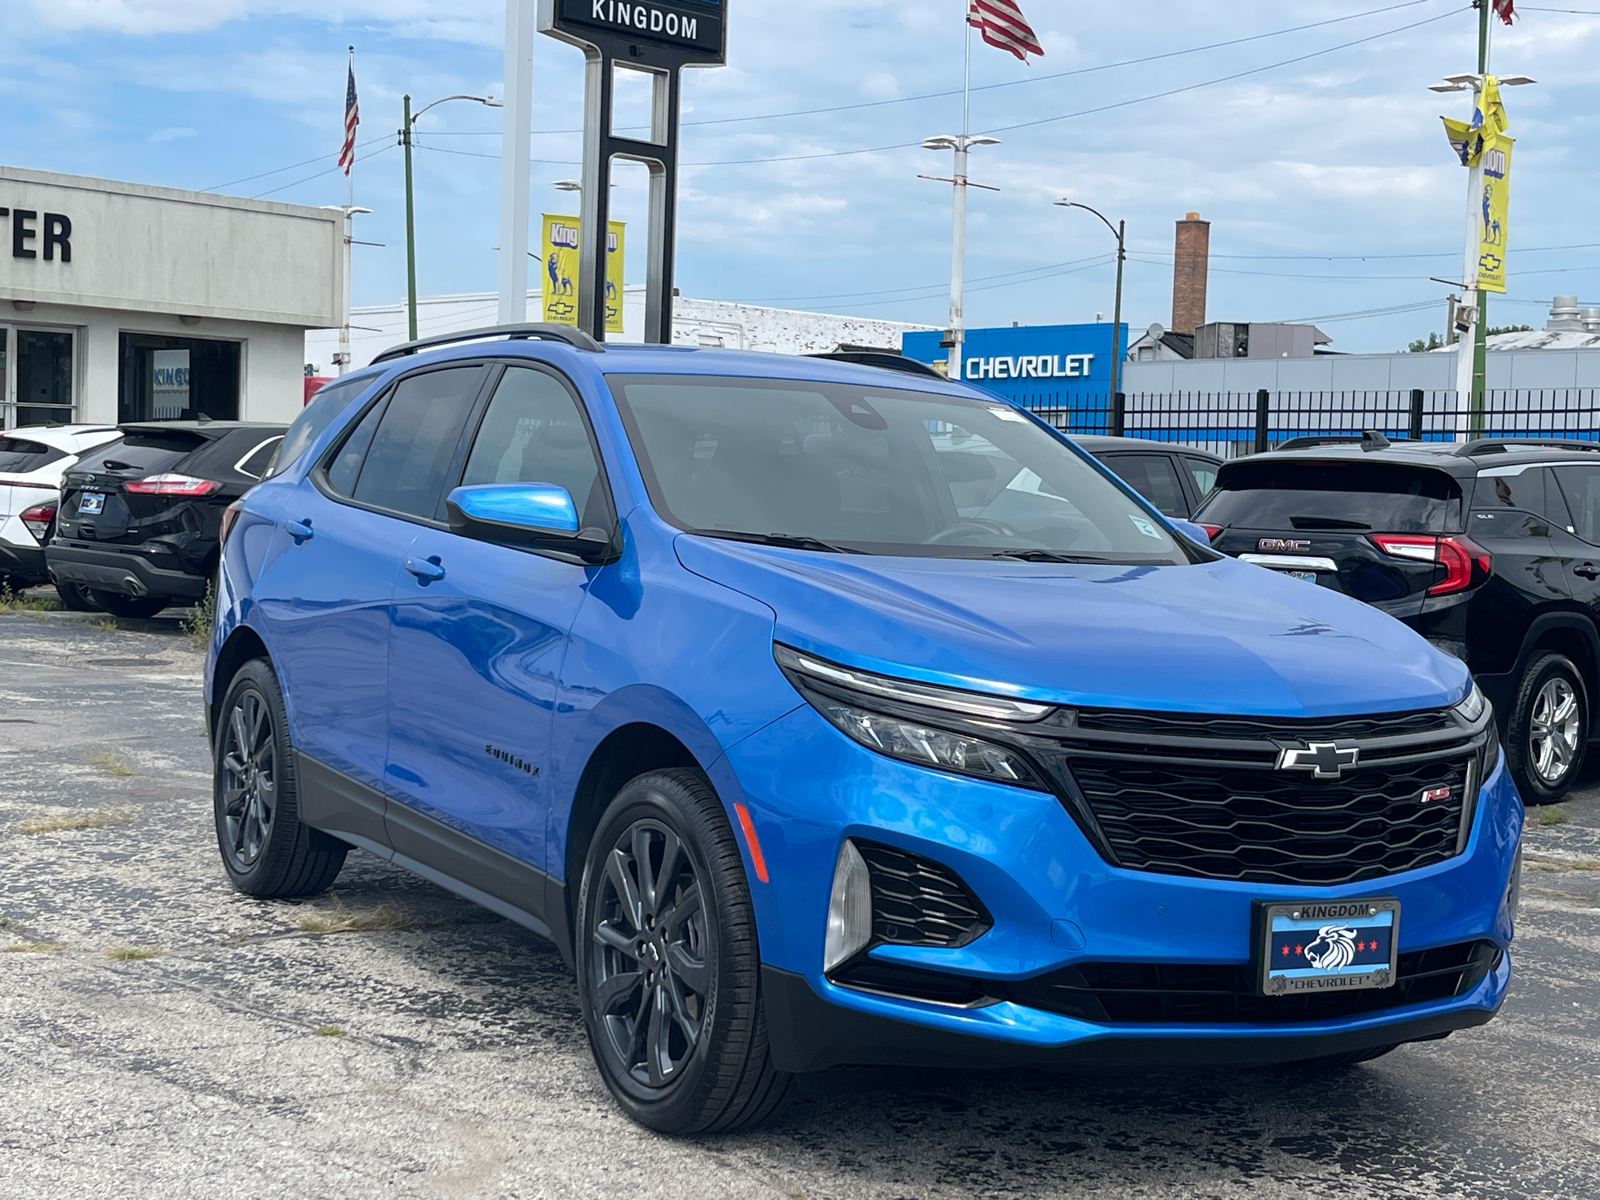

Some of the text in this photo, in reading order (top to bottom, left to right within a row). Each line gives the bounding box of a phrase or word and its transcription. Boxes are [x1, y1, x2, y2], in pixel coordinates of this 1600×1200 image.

[592, 0, 697, 40] KINGDOM
[551, 223, 578, 249] King
[966, 353, 1095, 379] CHEVROLET
[1259, 538, 1310, 551] GMC
[1421, 787, 1450, 802] RS
[1301, 904, 1370, 918] KINGDOM
[1294, 975, 1365, 990] CHEVROLET
